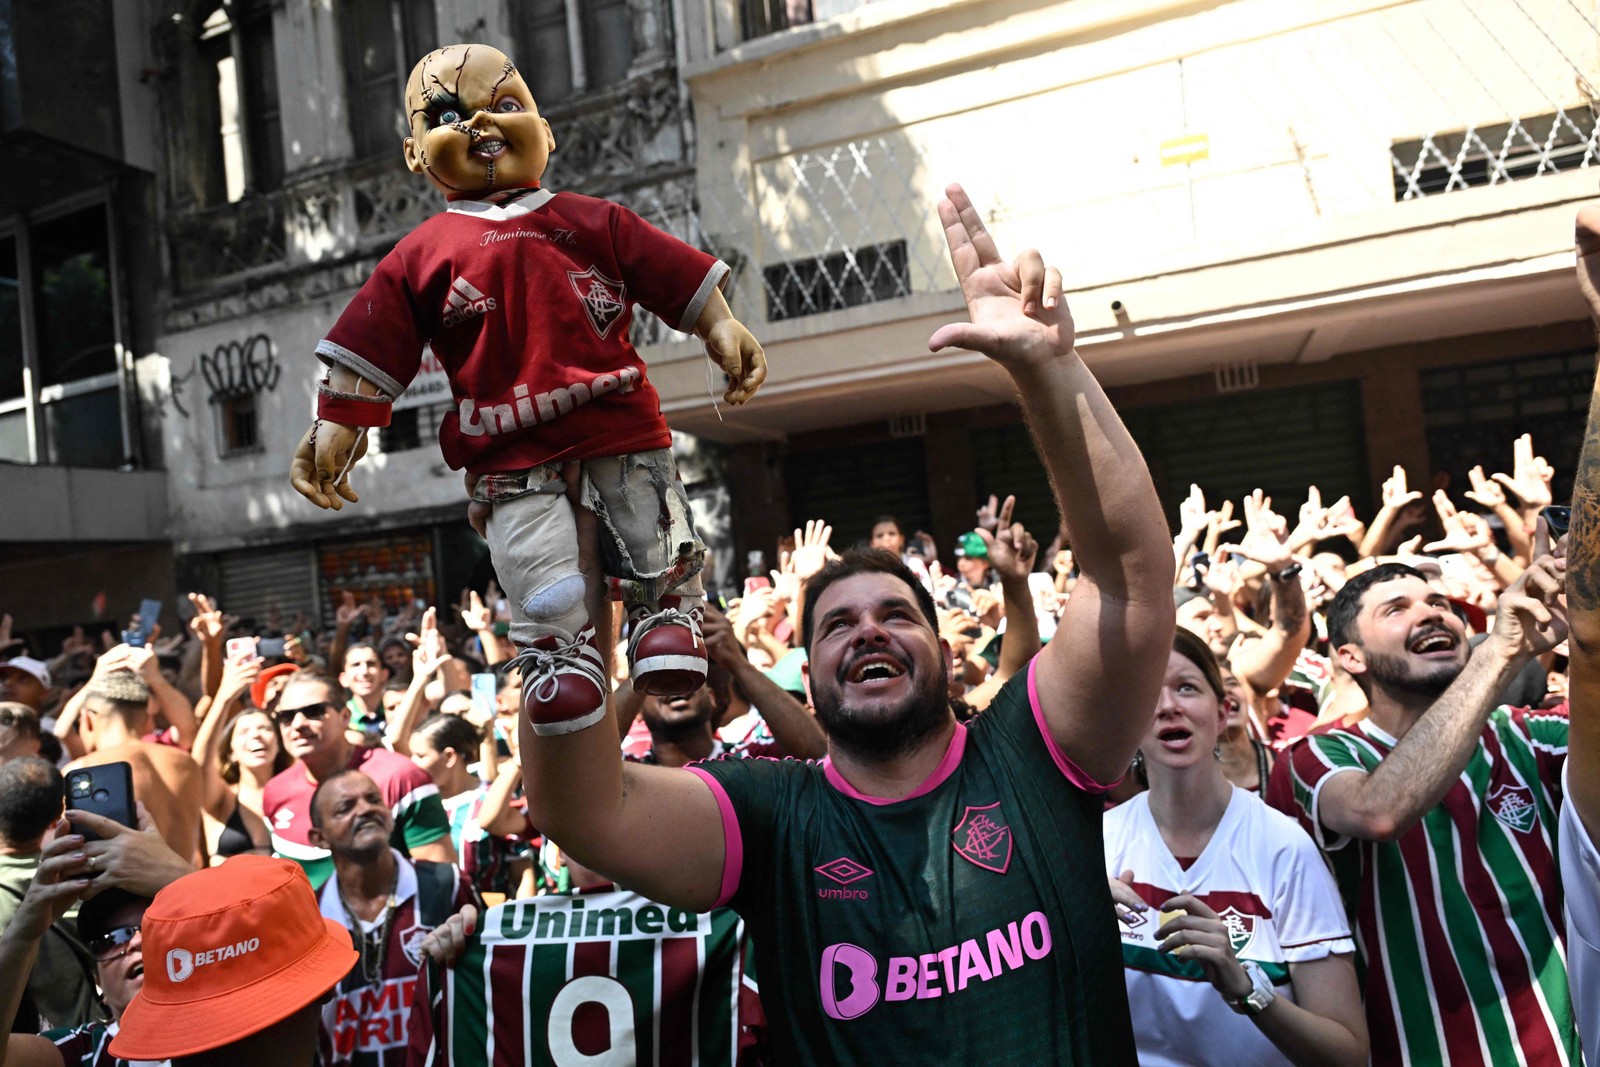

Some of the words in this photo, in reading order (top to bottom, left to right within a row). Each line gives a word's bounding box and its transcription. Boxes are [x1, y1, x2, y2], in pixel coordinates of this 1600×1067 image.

[480, 228, 546, 246] Fluminense
[443, 297, 497, 328] adidas
[819, 887, 869, 900] umbro
[195, 937, 260, 967] BETANO
[884, 911, 1052, 1002] BETANO
